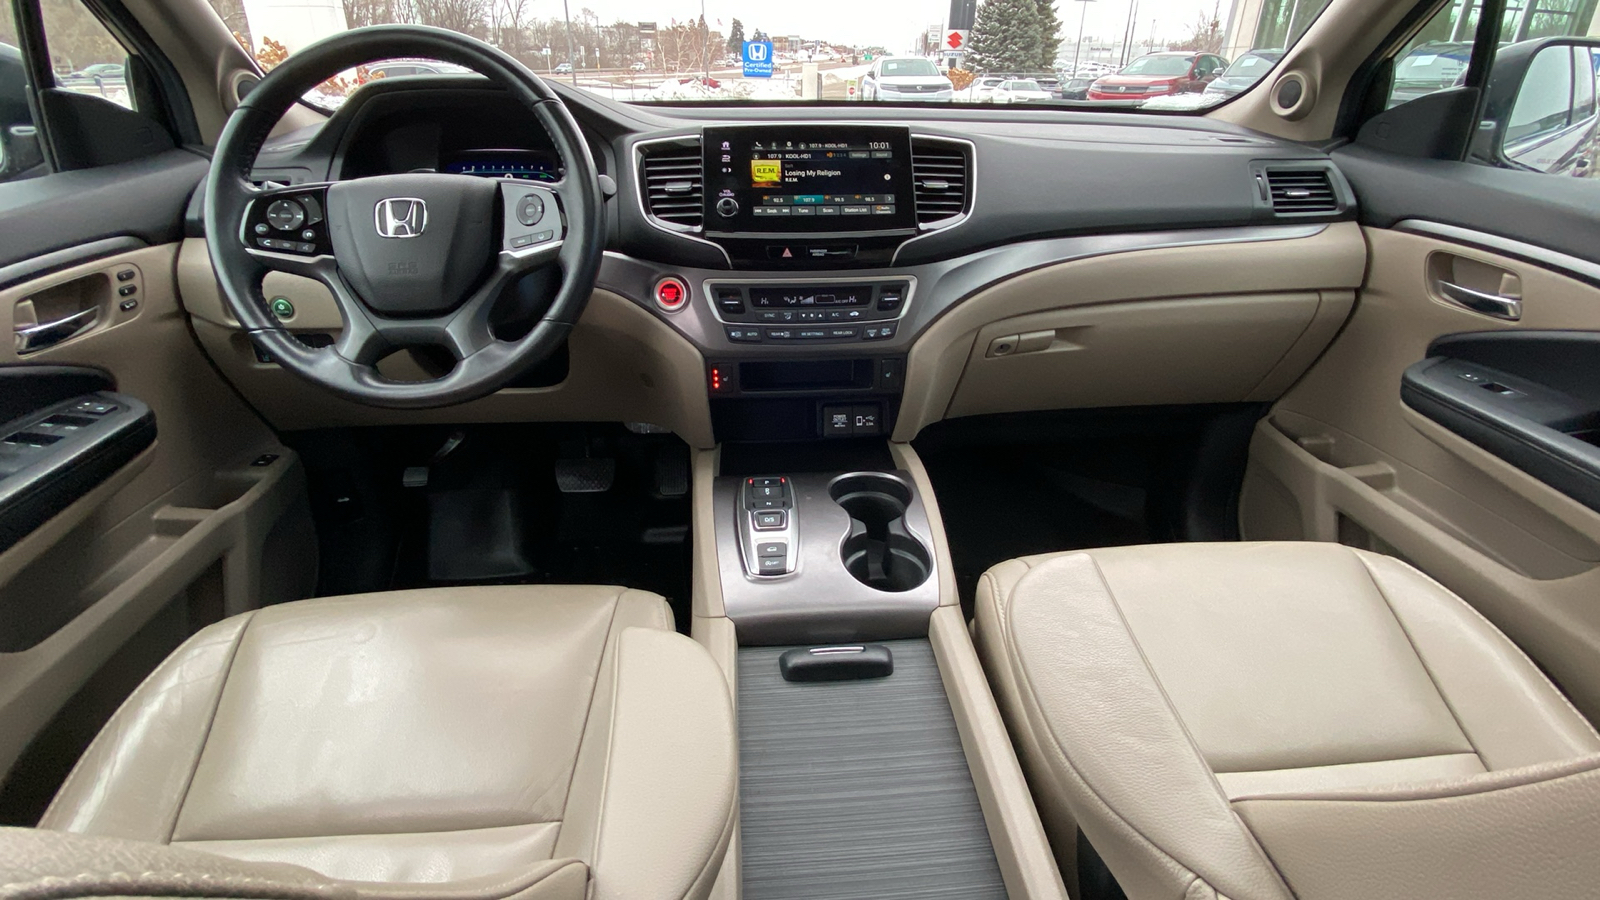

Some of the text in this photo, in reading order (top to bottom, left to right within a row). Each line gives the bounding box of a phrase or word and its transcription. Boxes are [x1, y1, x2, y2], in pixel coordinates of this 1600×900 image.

[785, 170, 842, 178] Losing My Religion
